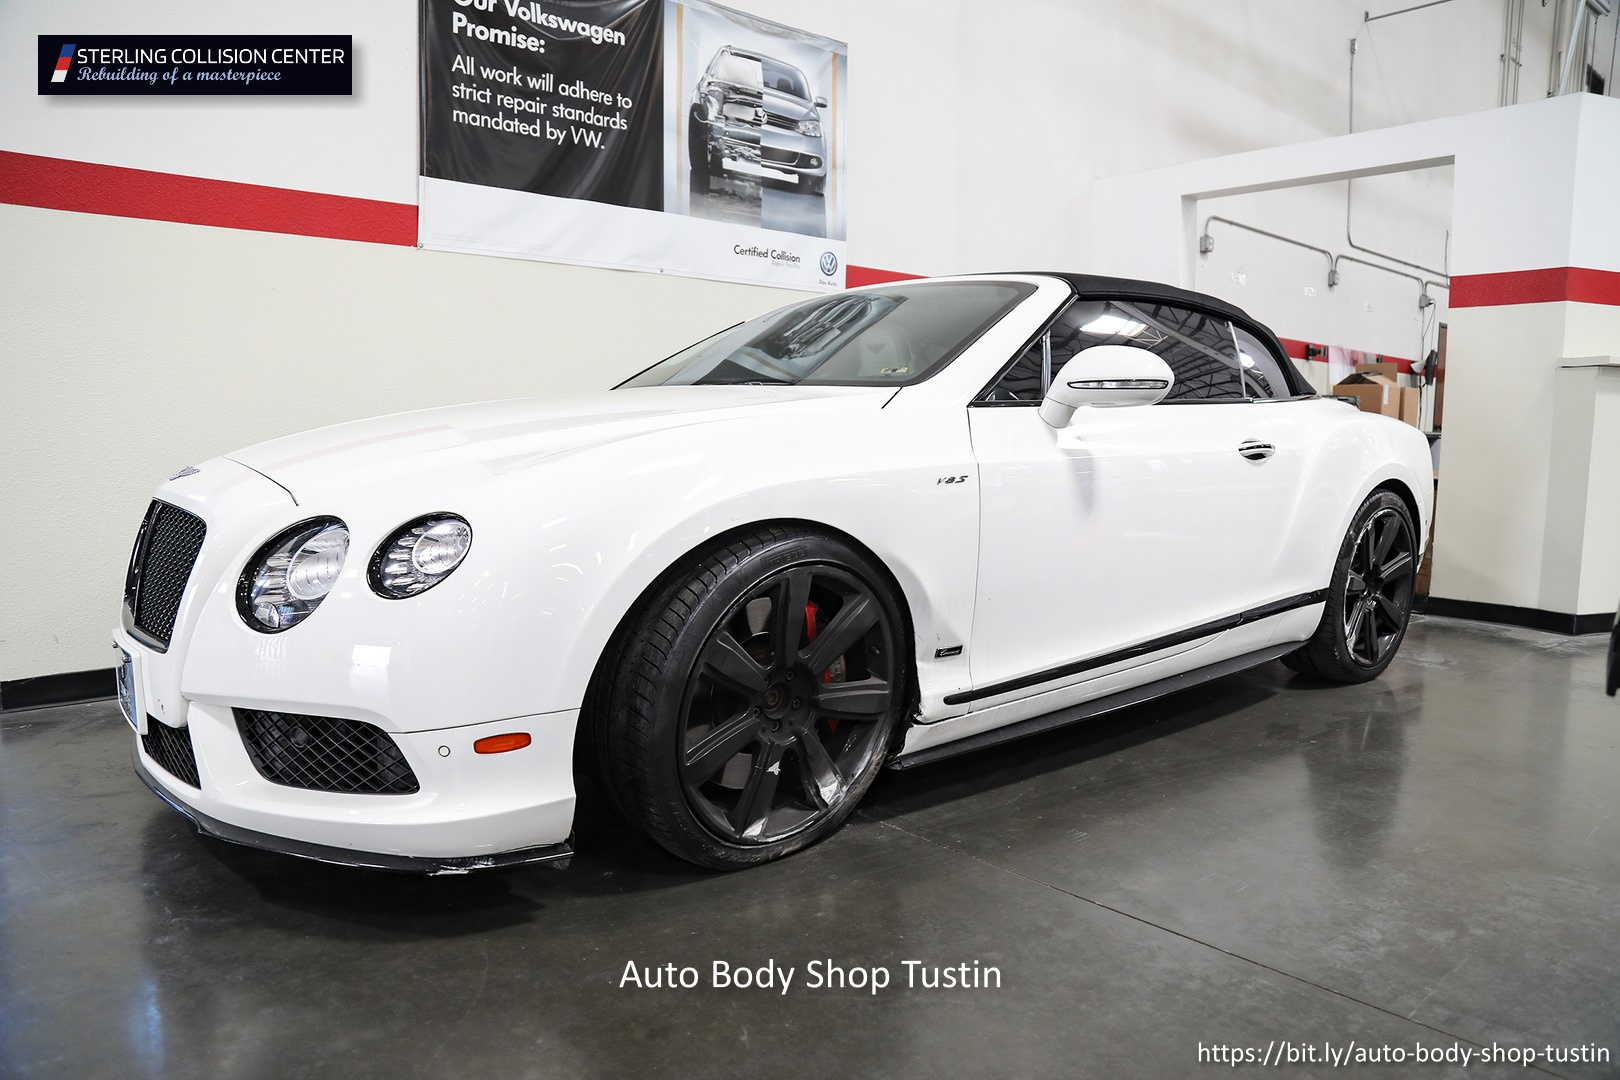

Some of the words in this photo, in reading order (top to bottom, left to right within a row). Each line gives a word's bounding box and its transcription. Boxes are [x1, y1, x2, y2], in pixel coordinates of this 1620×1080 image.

[452, 11, 546, 54] Promise:
[503, 0, 626, 46] Volkswagen
[451, 54, 475, 76] All
[480, 66, 523, 87] work
[527, 73, 554, 93] will
[558, 80, 613, 106] adhere
[616, 93, 633, 109] to
[452, 83, 492, 104] strict
[497, 93, 547, 115] repair
[552, 103, 628, 130] standards
[452, 108, 540, 137] mandated
[546, 120, 567, 145] by
[571, 126, 606, 150] VW.
[733, 244, 769, 258] Certified
[770, 249, 801, 263] Collision
